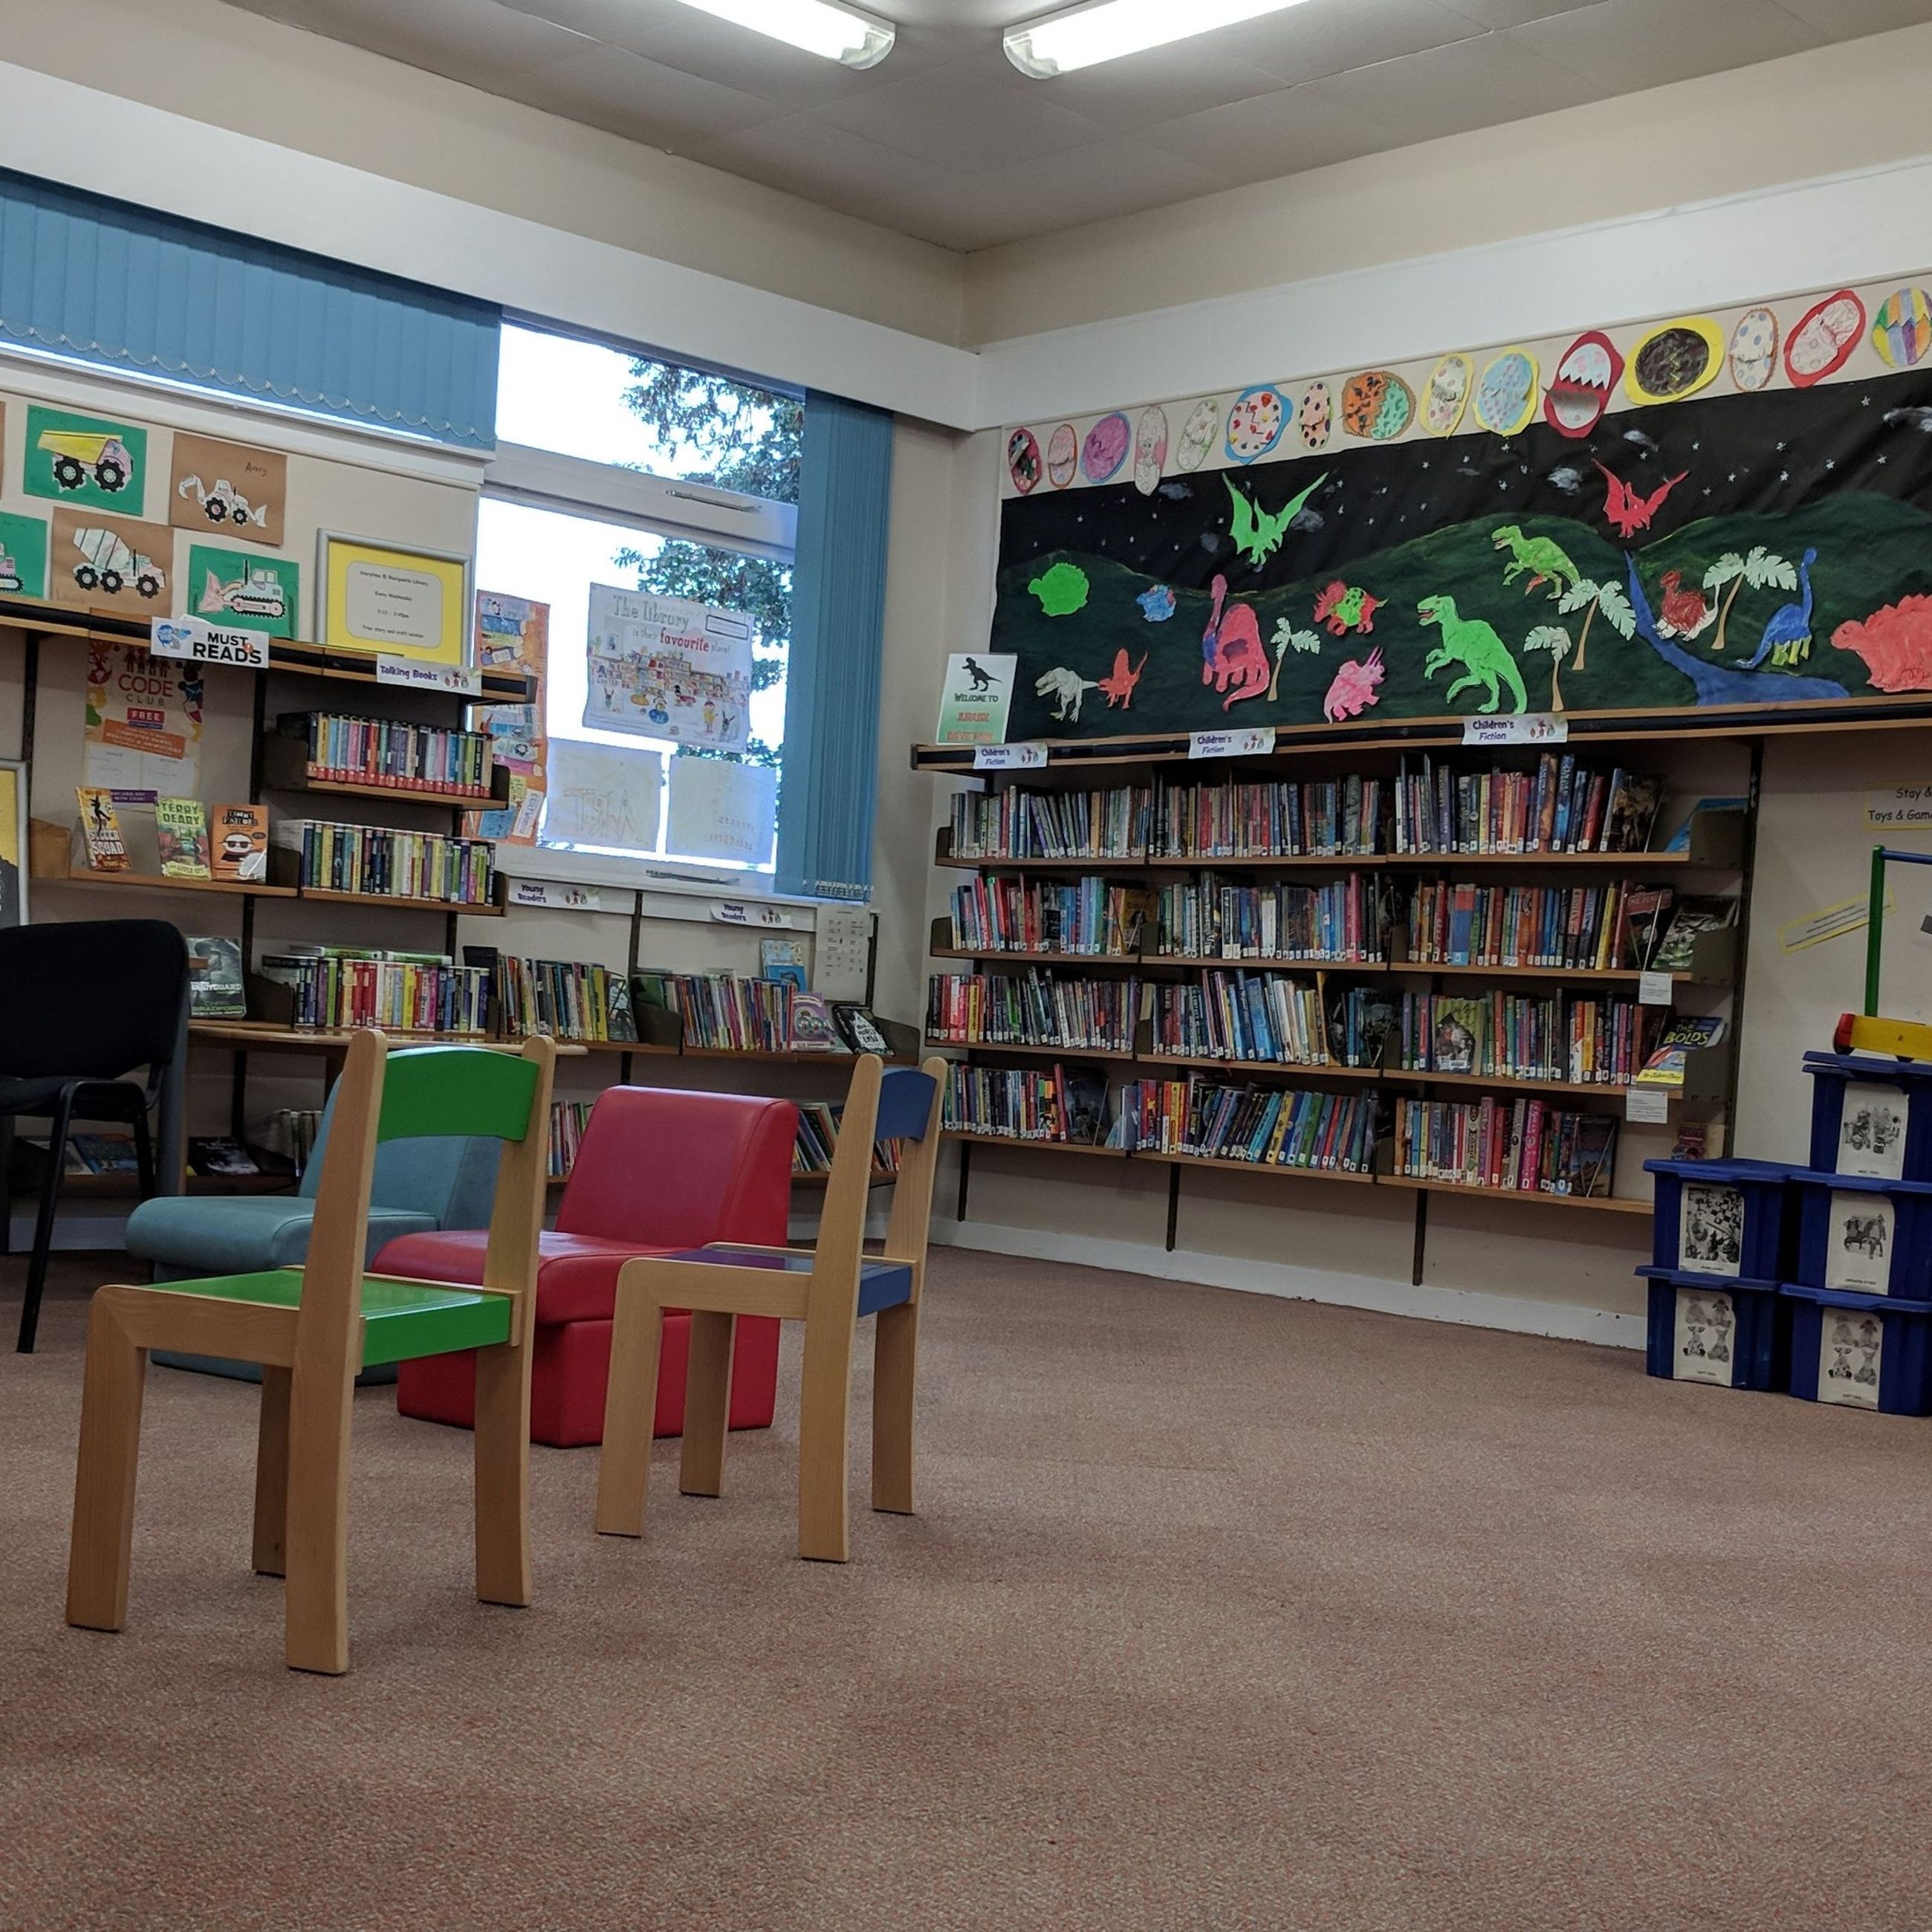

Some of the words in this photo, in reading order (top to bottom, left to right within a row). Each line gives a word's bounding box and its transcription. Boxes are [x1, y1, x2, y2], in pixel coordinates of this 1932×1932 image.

[613, 594, 638, 618] The
[643, 599, 690, 633] library
[207, 632, 248, 646] MUST
[660, 628, 710, 652] favourite
[192, 642, 262, 664] READS
[380, 665, 411, 681] Talking
[412, 669, 438, 681] Books
[118, 674, 173, 698] CODE
[126, 694, 165, 707] CLUB
[954, 693, 987, 703] WELCOME
[132, 710, 161, 722] FREE
[1472, 719, 1515, 730] Children's
[1197, 735, 1232, 745] Children's
[1479, 732, 1507, 741] Fiction
[981, 748, 1011, 756] Children's
[1202, 746, 1225, 754] Fiction
[985, 758, 1005, 766] Fiction
[1896, 788, 1922, 801] Stay
[160, 803, 198, 814] TERRY
[163, 813, 201, 825] DEARY
[1868, 810, 1893, 823] Toys
[1896, 809, 1903, 820] &
[92, 841, 125, 856] SQUAD
[521, 884, 545, 895] Young
[517, 892, 548, 904] Readers
[1663, 1031, 1711, 1046] BOLDS
